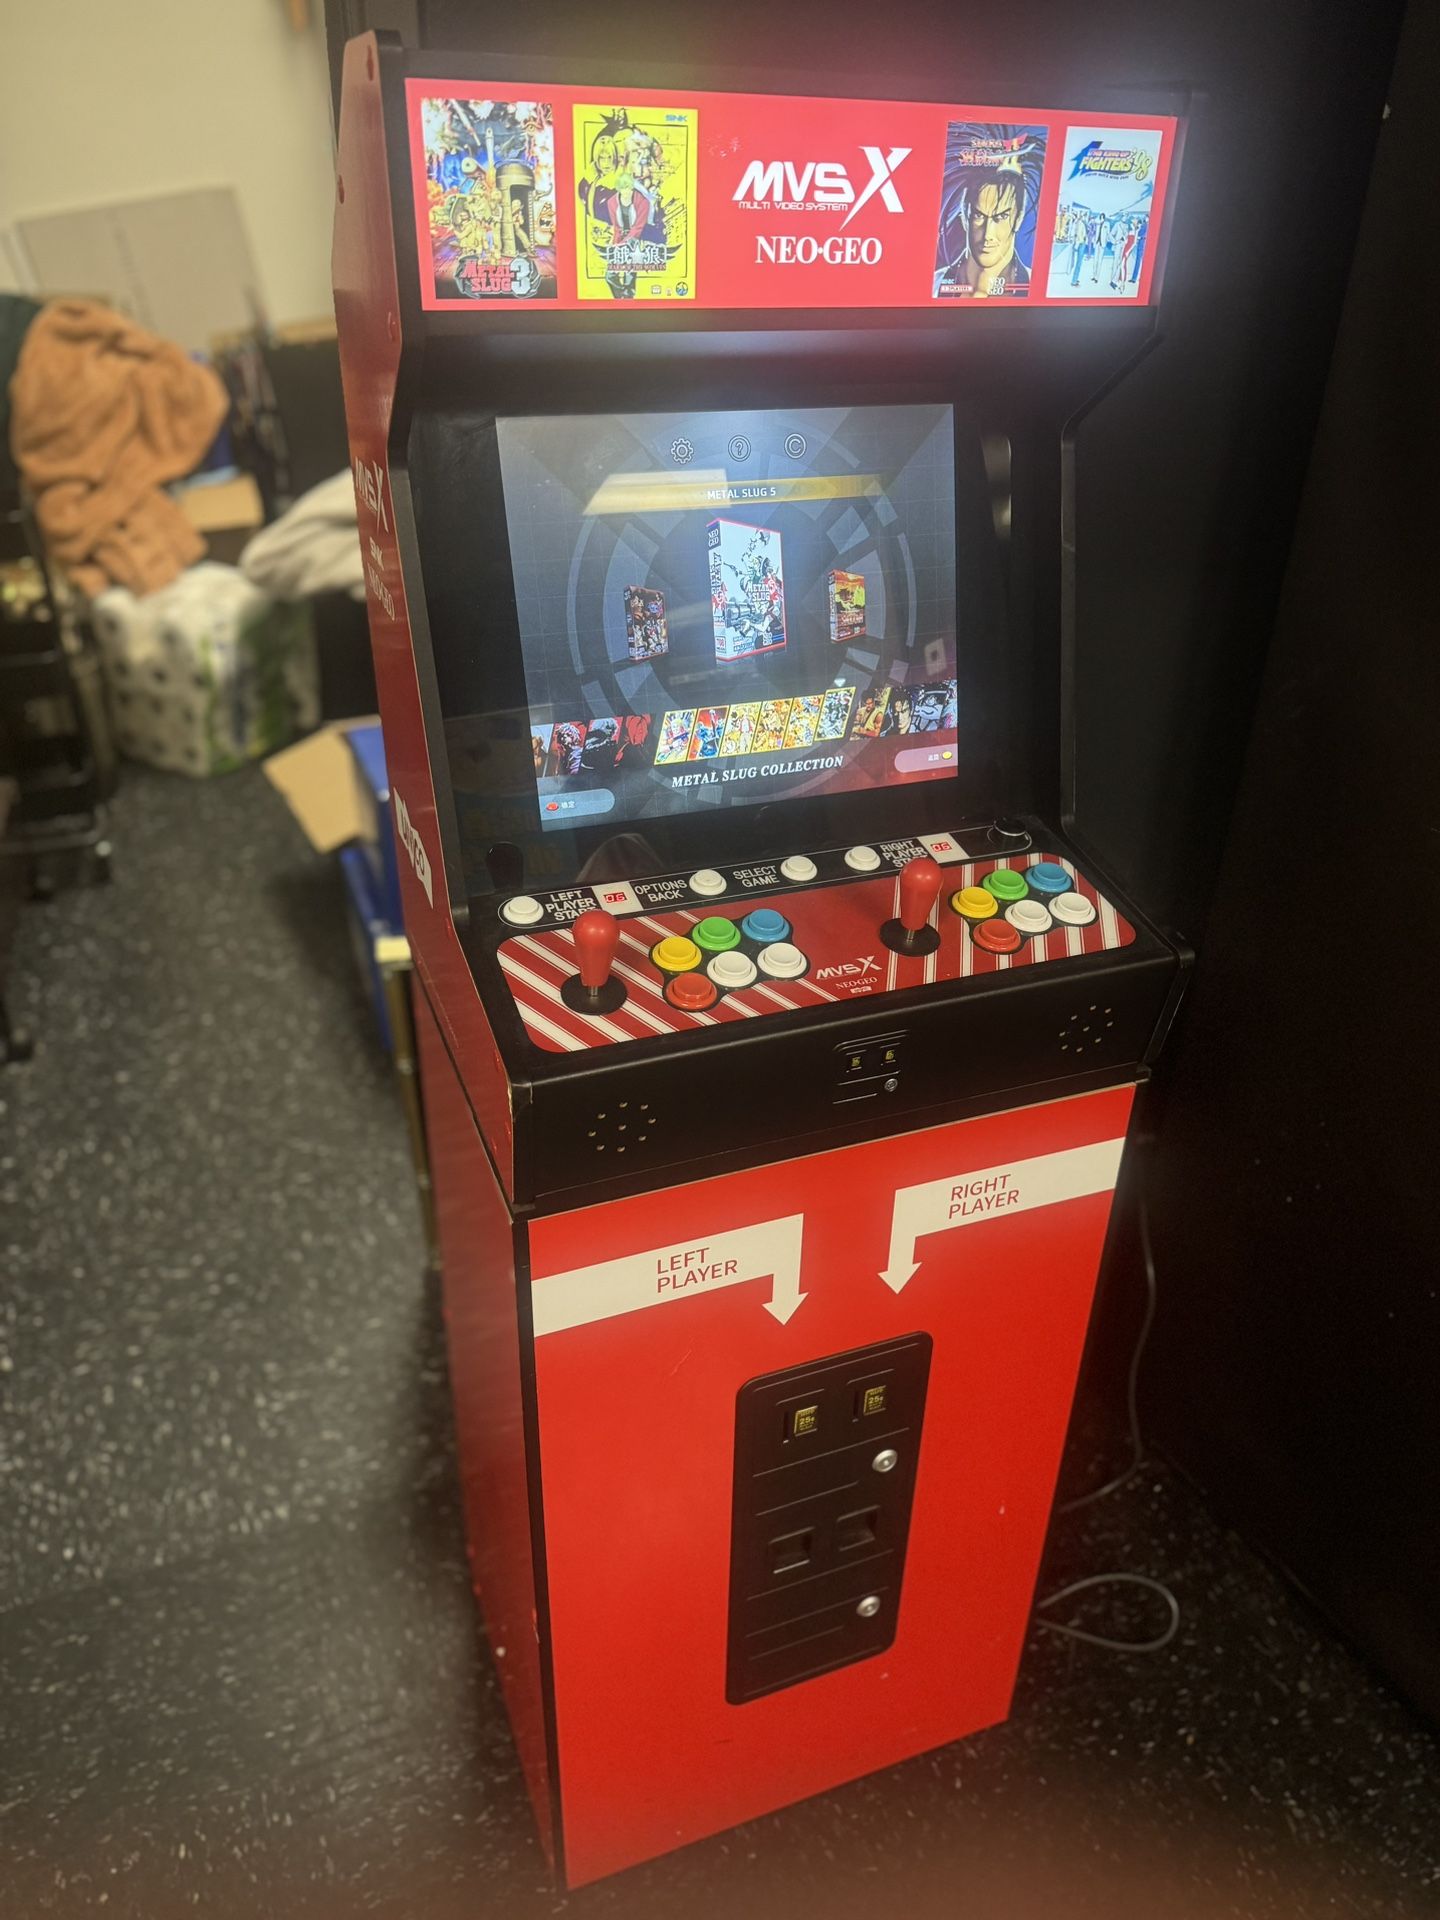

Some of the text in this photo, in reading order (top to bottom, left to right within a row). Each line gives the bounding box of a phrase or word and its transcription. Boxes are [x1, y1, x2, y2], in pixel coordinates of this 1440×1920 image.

[1079, 156, 1132, 172] FIGHTERS
[738, 201, 849, 212] MULTI VIDEO SYSTEM
[461, 260, 514, 278] METAL
[471, 258, 531, 295] SLUG 3
[707, 487, 776, 500] METAL SLUG 5
[752, 592, 770, 601] SLUG
[671, 755, 843, 788] METAL SLUG COLLECTION
[880, 840, 914, 852] RIGHT
[882, 847, 928, 860] PLAYER
[732, 865, 777, 880] SELECT
[634, 880, 688, 895] OPTIONS
[742, 874, 780, 888] GAME
[550, 890, 582, 902] LEFT
[647, 890, 684, 902] BACK
[545, 898, 597, 913] PLAYER
[554, 906, 596, 921] STA
[951, 1174, 1011, 1201] RIGHT
[949, 1190, 1019, 1219] PLAYER
[657, 1247, 710, 1274] LEFT
[657, 1259, 738, 1293] PLAYER
